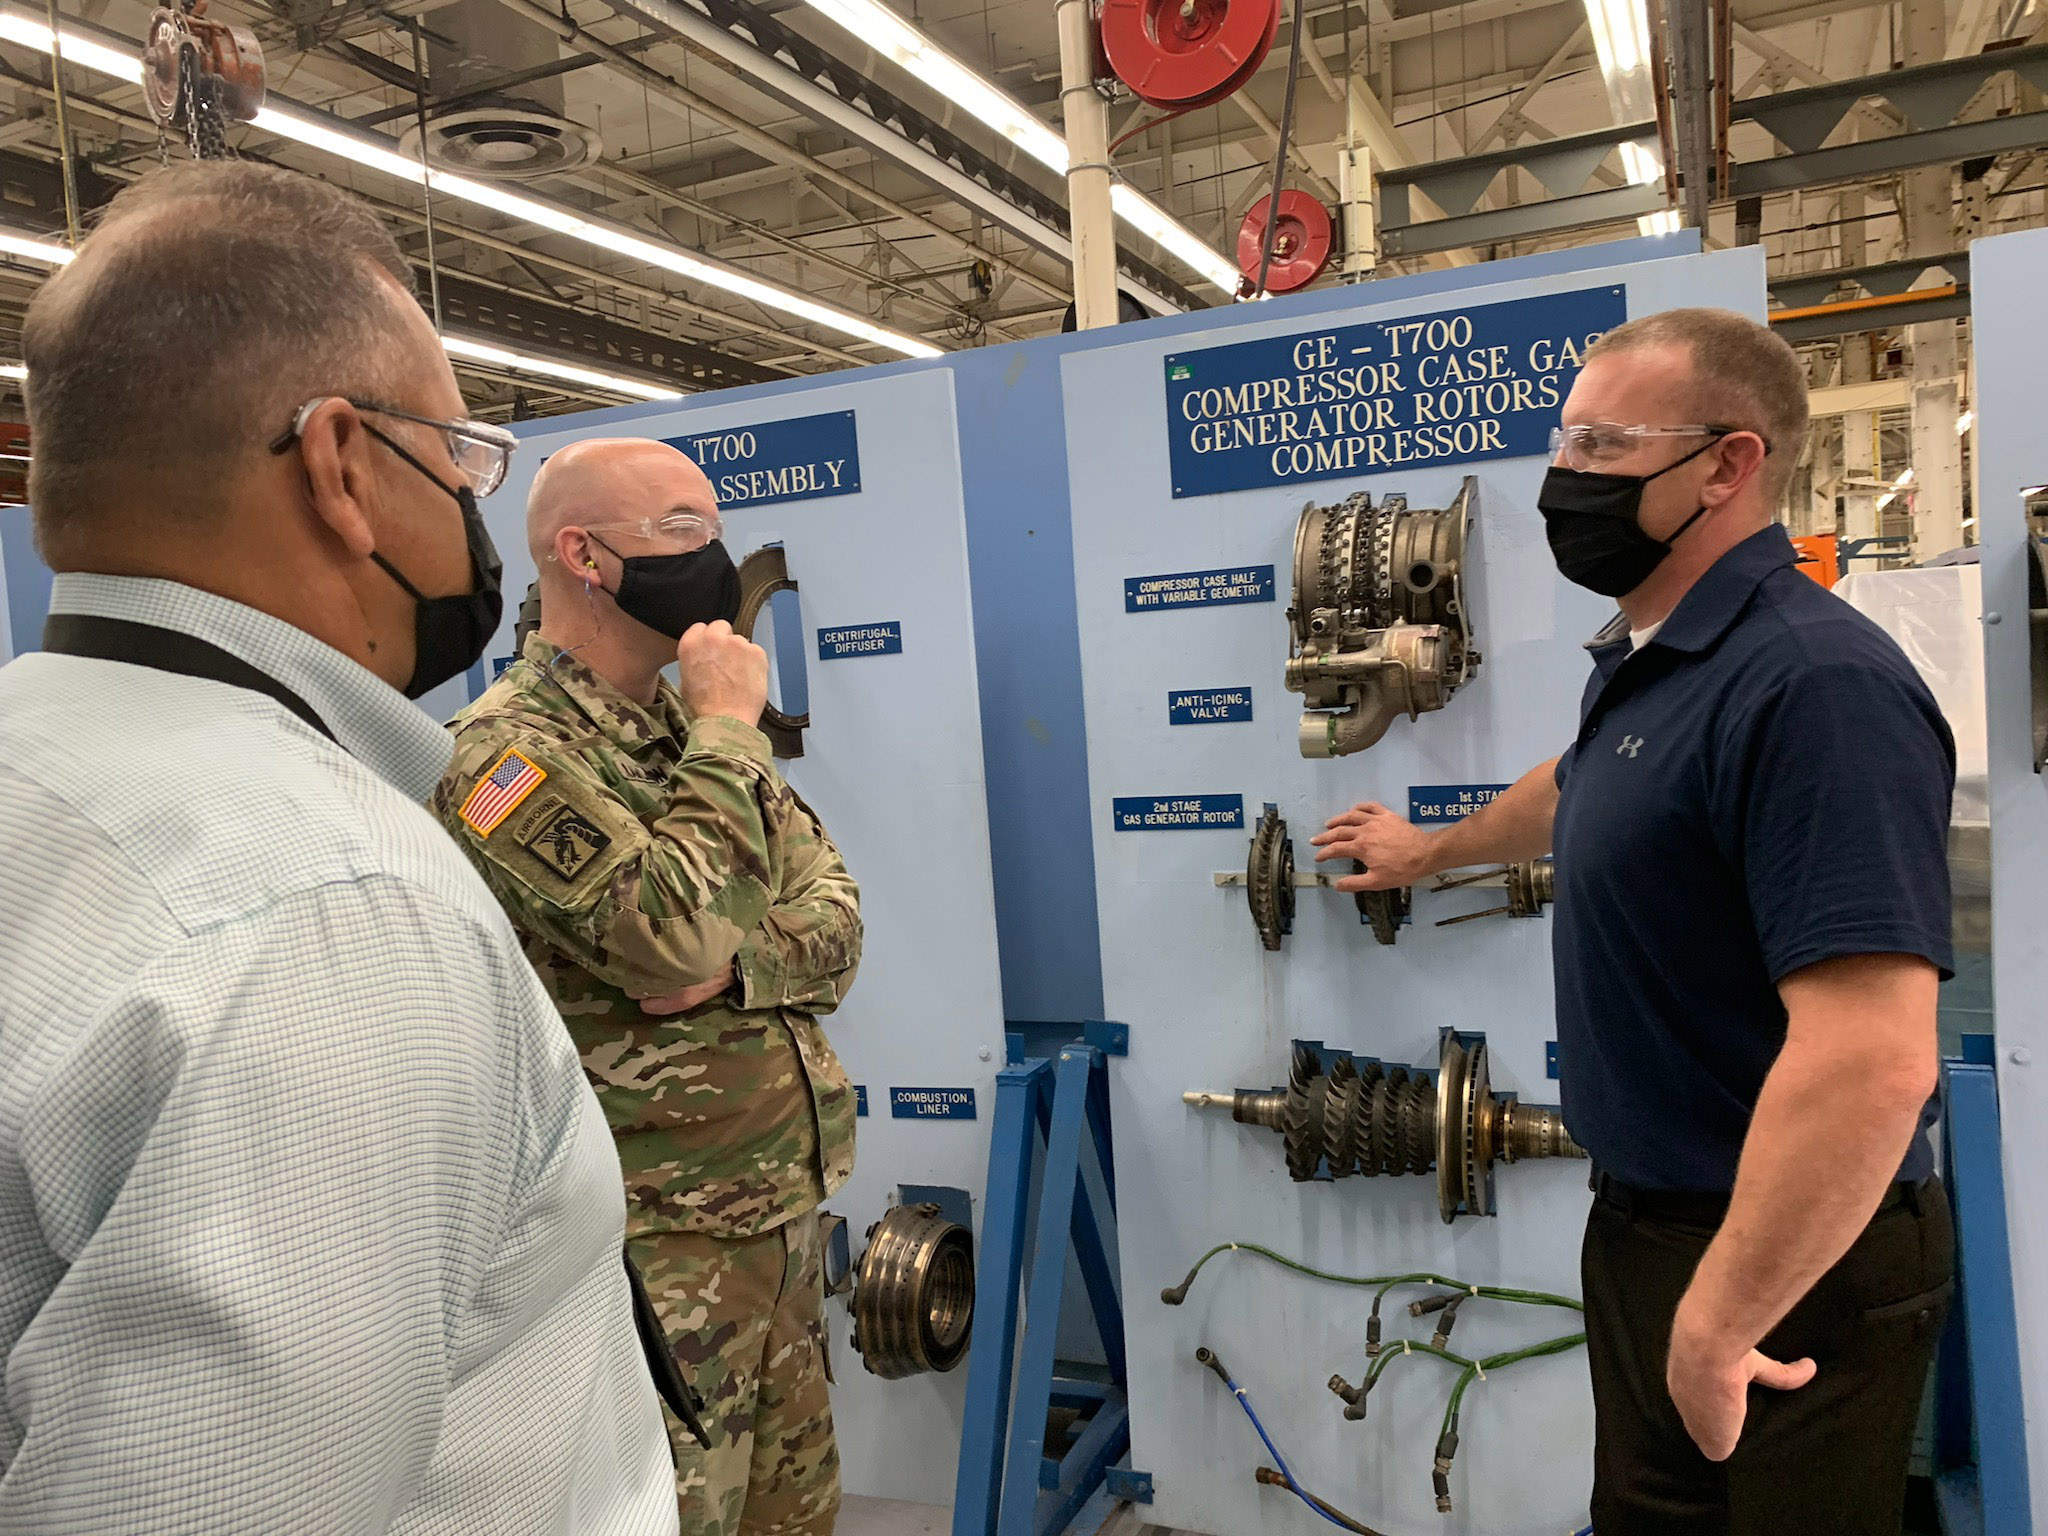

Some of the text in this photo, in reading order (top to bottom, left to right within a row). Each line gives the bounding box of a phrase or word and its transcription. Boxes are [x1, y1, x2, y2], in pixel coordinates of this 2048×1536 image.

[1293, 335, 1339, 371] GE
[1384, 315, 1473, 358] T700
[1182, 361, 1407, 422] COMPRESSOR
[1418, 345, 1517, 388] CASE,
[1190, 375, 1560, 454] GENERATOR ROTORS
[693, 431, 757, 465] T700
[1271, 418, 1508, 477] COMPRESSOR
[1140, 571, 1256, 593] COMPRESSOR CASE HALF
[1136, 584, 1262, 606] WITH VARIABLE GEOMETRY
[824, 627, 894, 643] CENTRIFUGAL
[835, 639, 885, 654] DIFFUSER
[1176, 693, 1243, 707] ANTI-ICING
[1190, 706, 1229, 719] VALVE
[1459, 791, 1472, 802] 1st
[1153, 800, 1202, 813] 2nd STAGE
[1420, 803, 1487, 816] GAS GENER
[518, 799, 560, 841] AIRBORNE
[1123, 811, 1236, 825] GAS GENERATOR ROTOR
[897, 1092, 968, 1104] COMBUSTION
[916, 1104, 950, 1115] LINER
